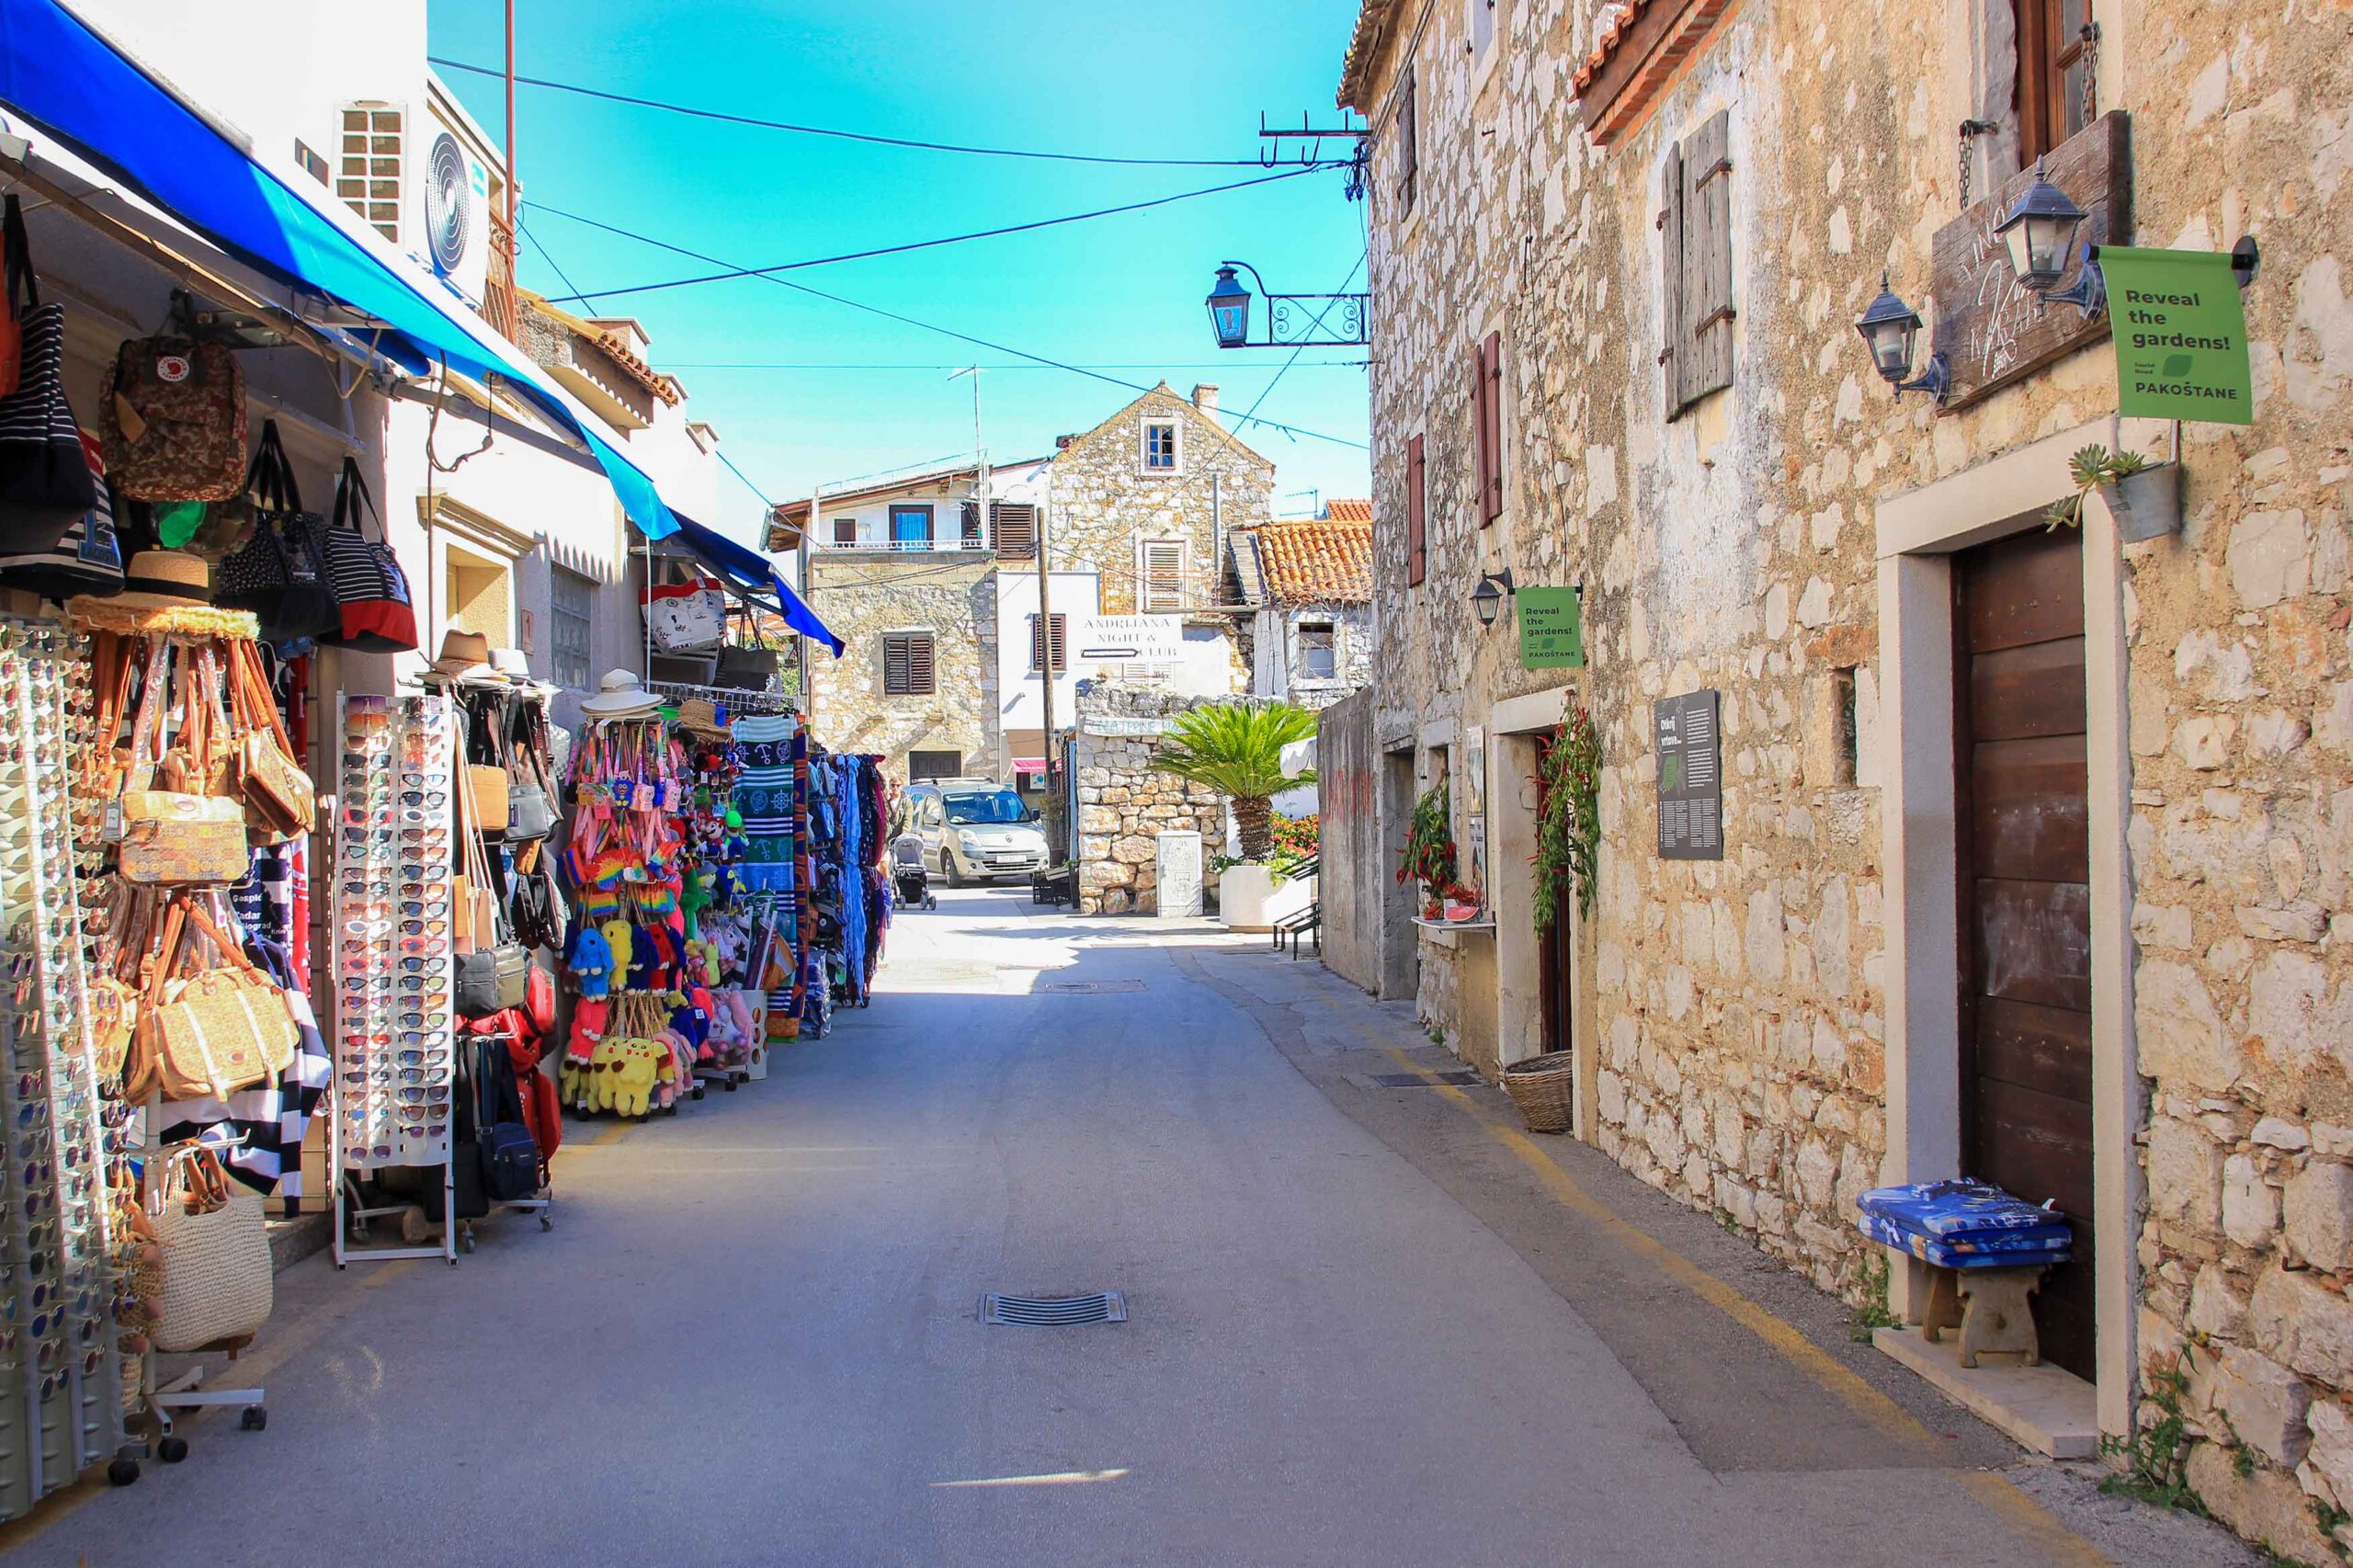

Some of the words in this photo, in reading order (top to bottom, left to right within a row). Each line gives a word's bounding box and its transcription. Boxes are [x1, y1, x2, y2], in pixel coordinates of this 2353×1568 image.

[2125, 290, 2200, 306] Reveal
[2129, 310, 2166, 325] the
[2132, 332, 2231, 350] gardens!
[2135, 381, 2237, 400] PAKOŠTANE
[1526, 607, 1560, 616] Reveal
[1527, 618, 1544, 626] the
[1528, 627, 1573, 637] gardens!
[1098, 634, 1140, 642] NIGHT
[1139, 647, 1177, 657] CLUB
[1660, 715, 1676, 733] Otkrij
[233, 893, 262, 903] Gospić
